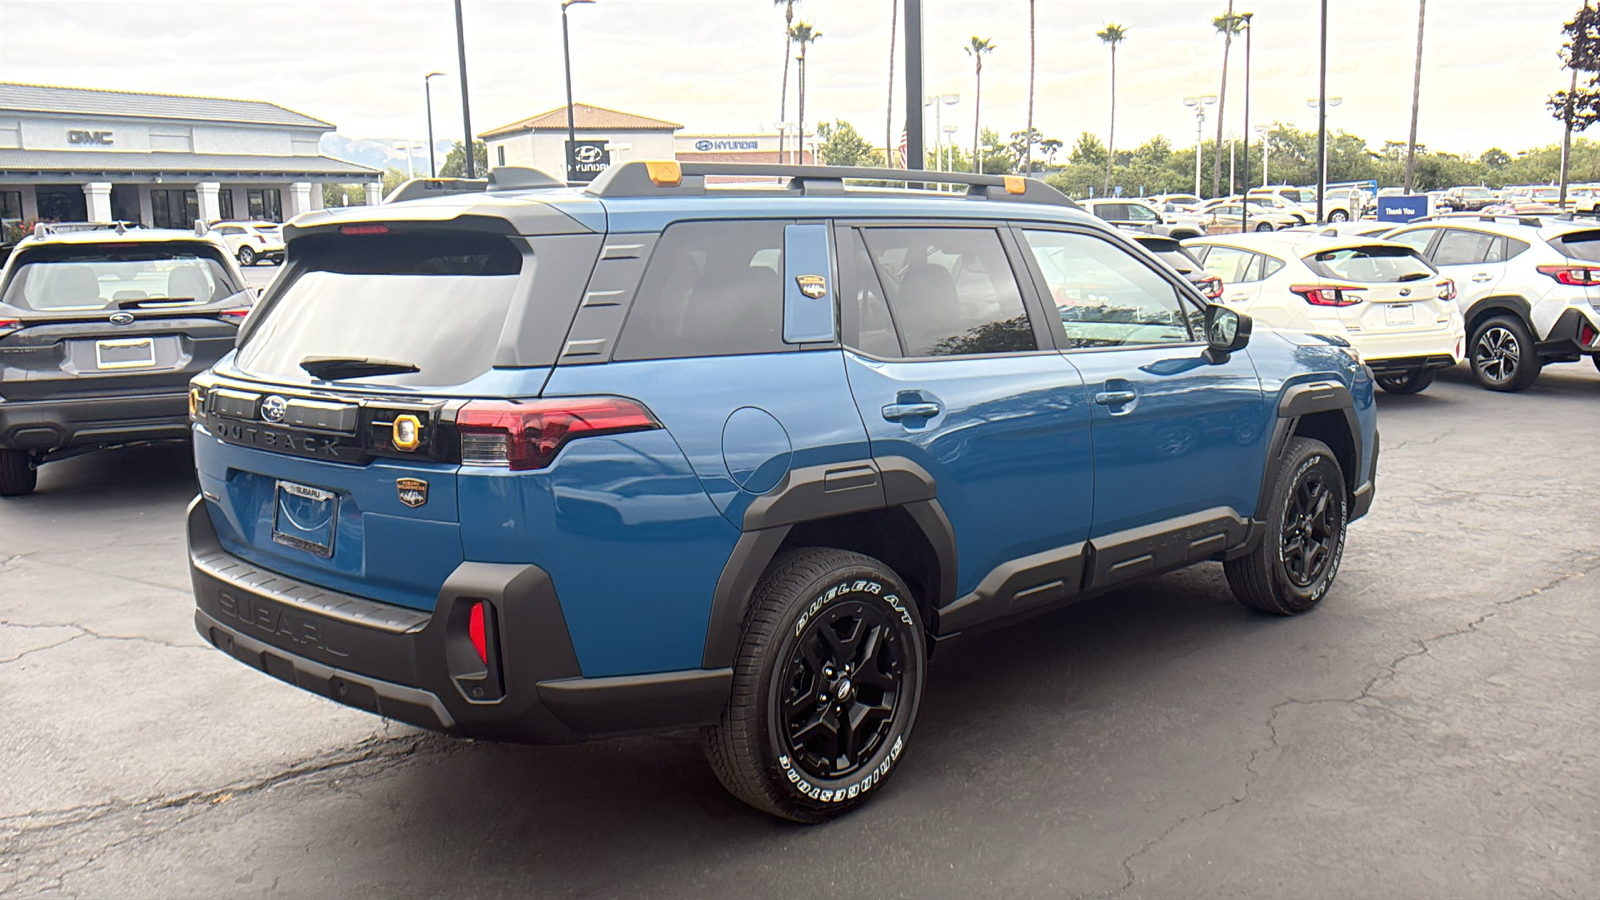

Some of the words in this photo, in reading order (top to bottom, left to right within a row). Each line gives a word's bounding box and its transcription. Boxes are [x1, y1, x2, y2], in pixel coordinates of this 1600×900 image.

[67, 130, 113, 145] GMC
[714, 141, 758, 150] HYUNDAI
[1385, 207, 1402, 215] Thank
[1403, 207, 1415, 215] You
[217, 422, 339, 457] OUTBACK
[296, 486, 321, 498] SUBARU
[795, 580, 881, 637] DUELER
[883, 594, 913, 626] A/T
